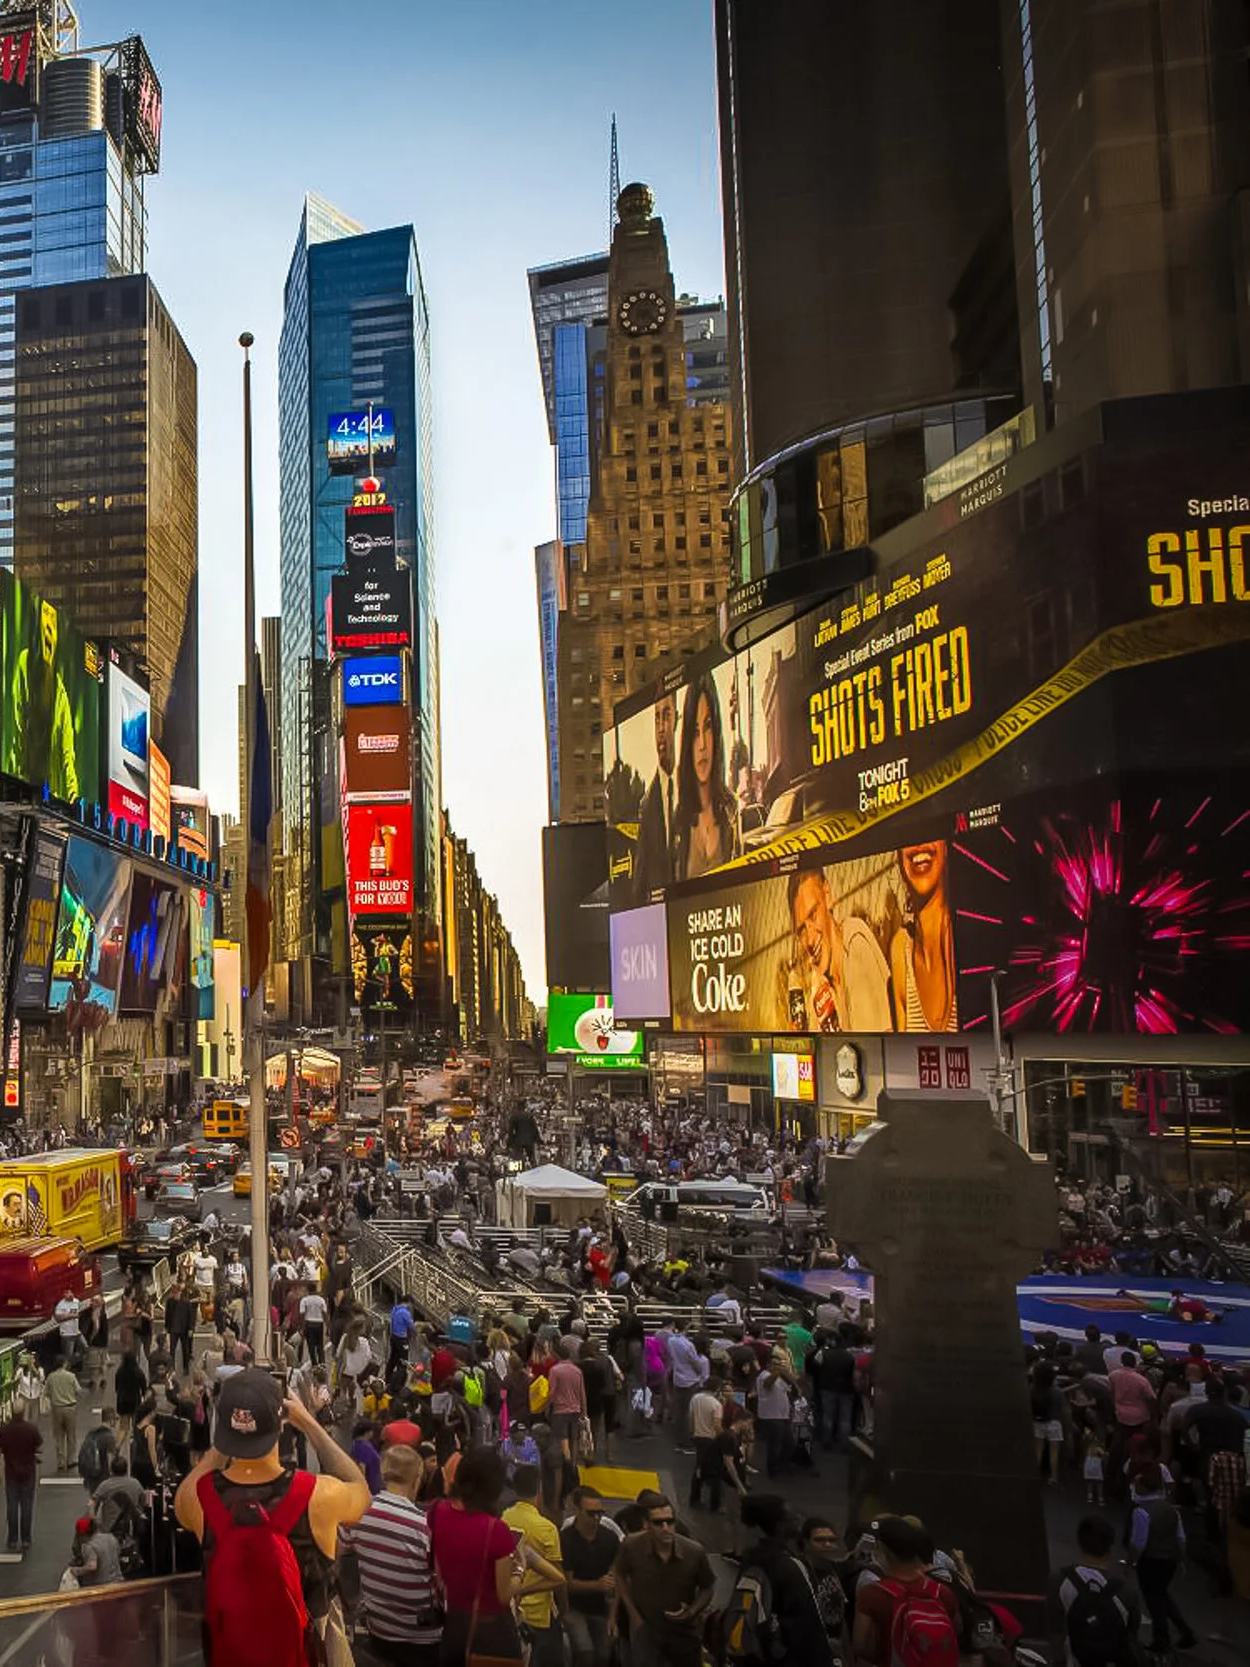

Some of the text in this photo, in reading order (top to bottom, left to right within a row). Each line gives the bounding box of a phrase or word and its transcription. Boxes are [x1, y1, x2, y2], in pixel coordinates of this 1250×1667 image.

[337, 413, 385, 435] 4:44
[961, 465, 1007, 501] MARRIOTT
[353, 493, 386, 507] 2017
[961, 484, 1004, 517] MARQUIS
[1187, 494, 1250, 518] Specia
[364, 581, 378, 590] for
[354, 592, 391, 603] Science
[363, 603, 381, 612] and
[347, 613, 400, 625] Technology
[824, 653, 850, 681] Special
[851, 643, 871, 668] Event
[871, 632, 895, 658] Series
[915, 603, 940, 635] FOX
[359, 673, 398, 687] TDK
[809, 625, 972, 768] SHOTS FIRED
[858, 757, 910, 791] TONIGHT
[877, 779, 901, 807] FOX
[901, 777, 910, 801] 5
[354, 880, 410, 892] THIS BUD'S
[354, 893, 375, 904] FOR
[687, 904, 741, 935] SHARE AN
[690, 933, 745, 962] ICE COLD
[620, 944, 657, 981] SKIN
[947, 1050, 967, 1068] UNI
